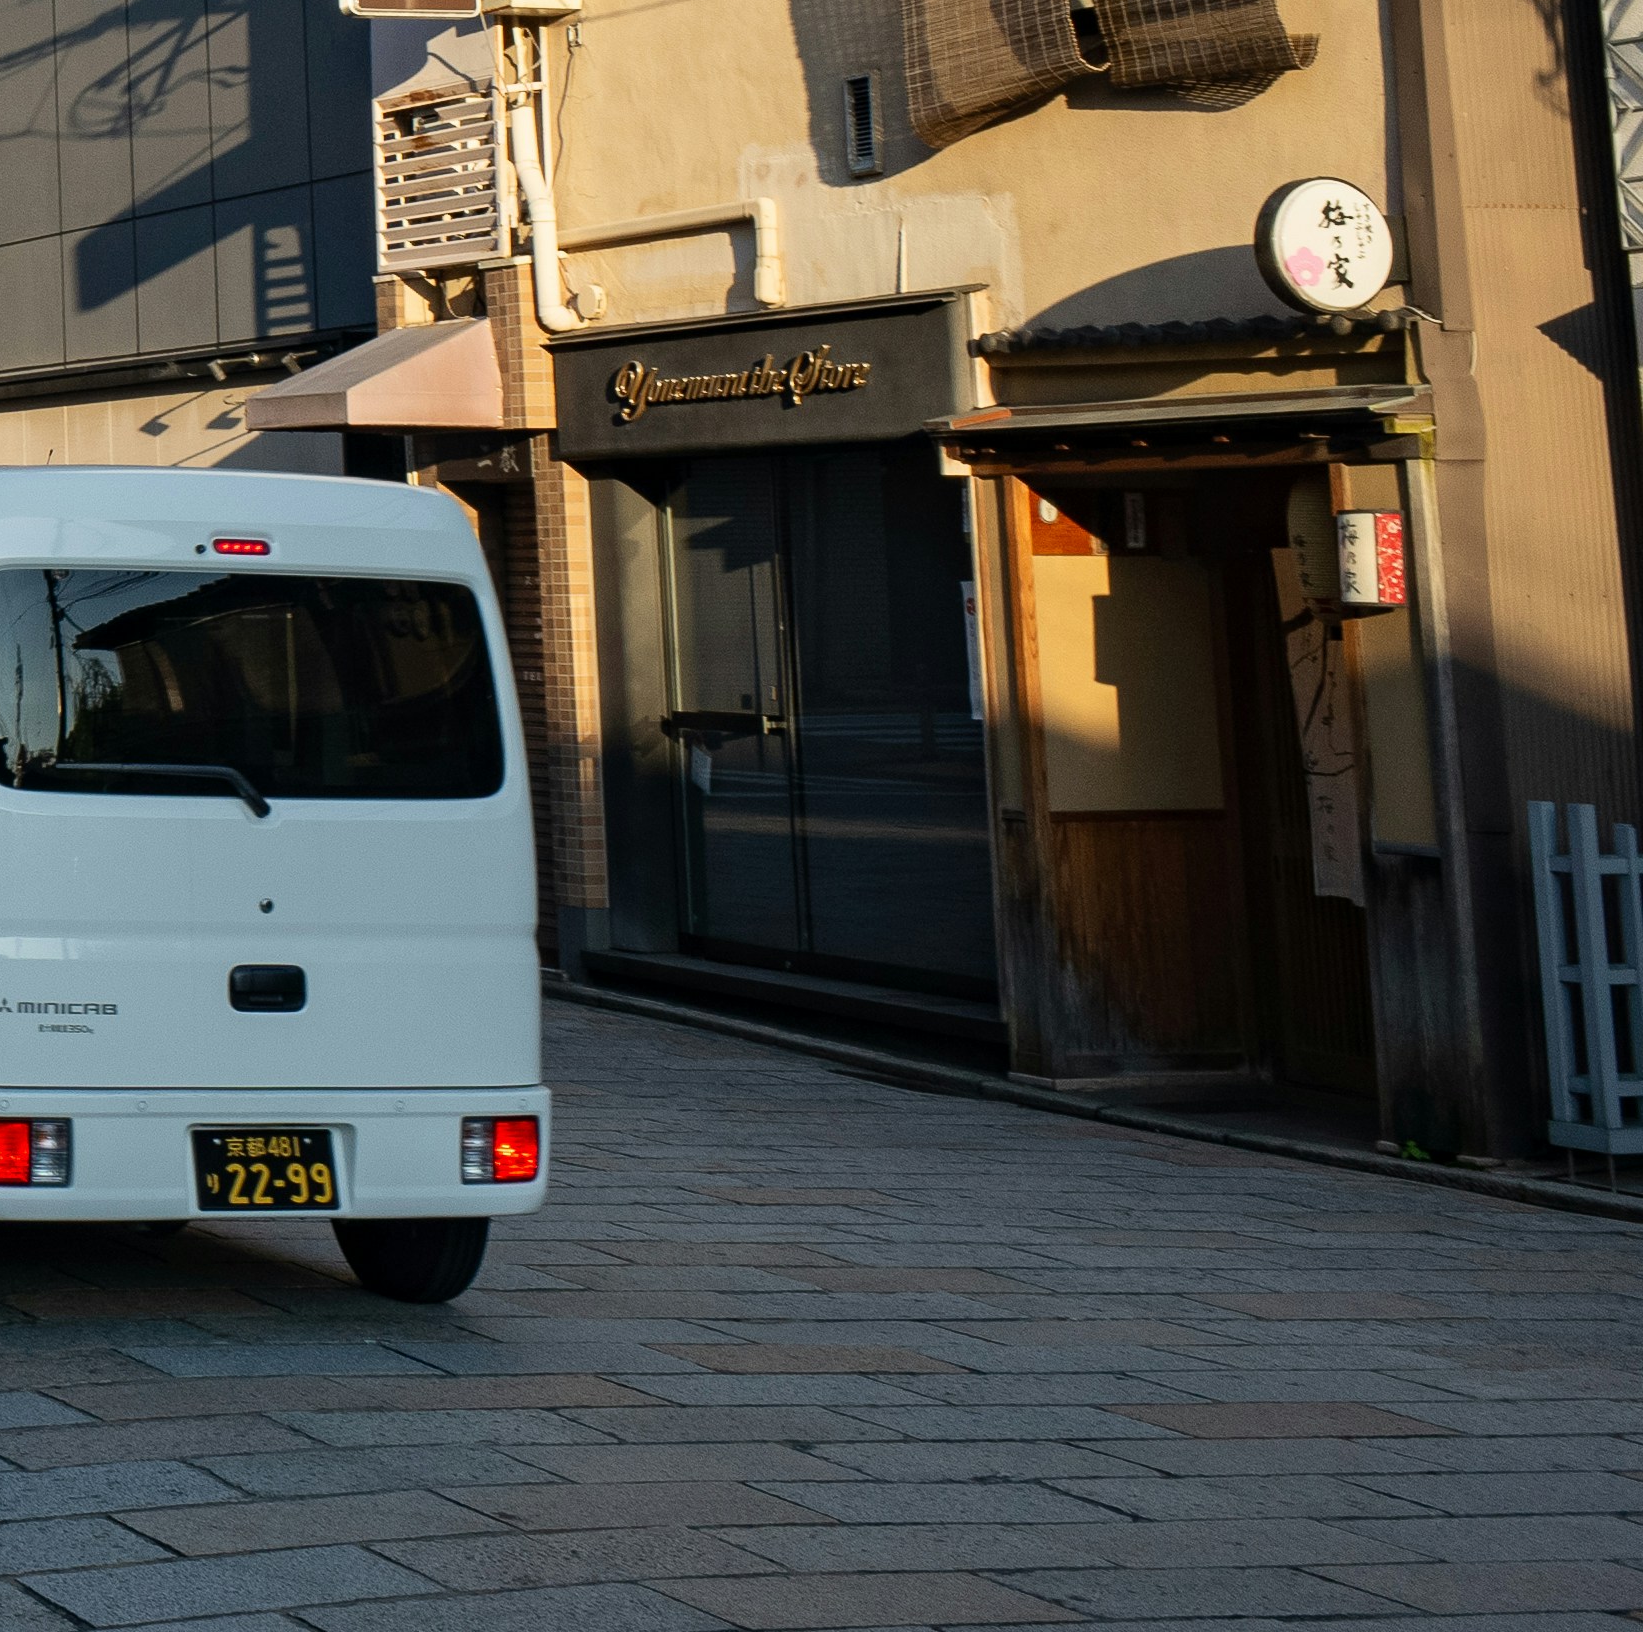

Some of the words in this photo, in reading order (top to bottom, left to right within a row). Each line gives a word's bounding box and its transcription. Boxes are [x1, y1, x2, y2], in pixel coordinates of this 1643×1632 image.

[789, 344, 872, 405] Store
[17, 1001, 119, 1016] MINICAB
[224, 1136, 301, 1158] 京都481
[225, 1162, 334, 1205] 22-99
